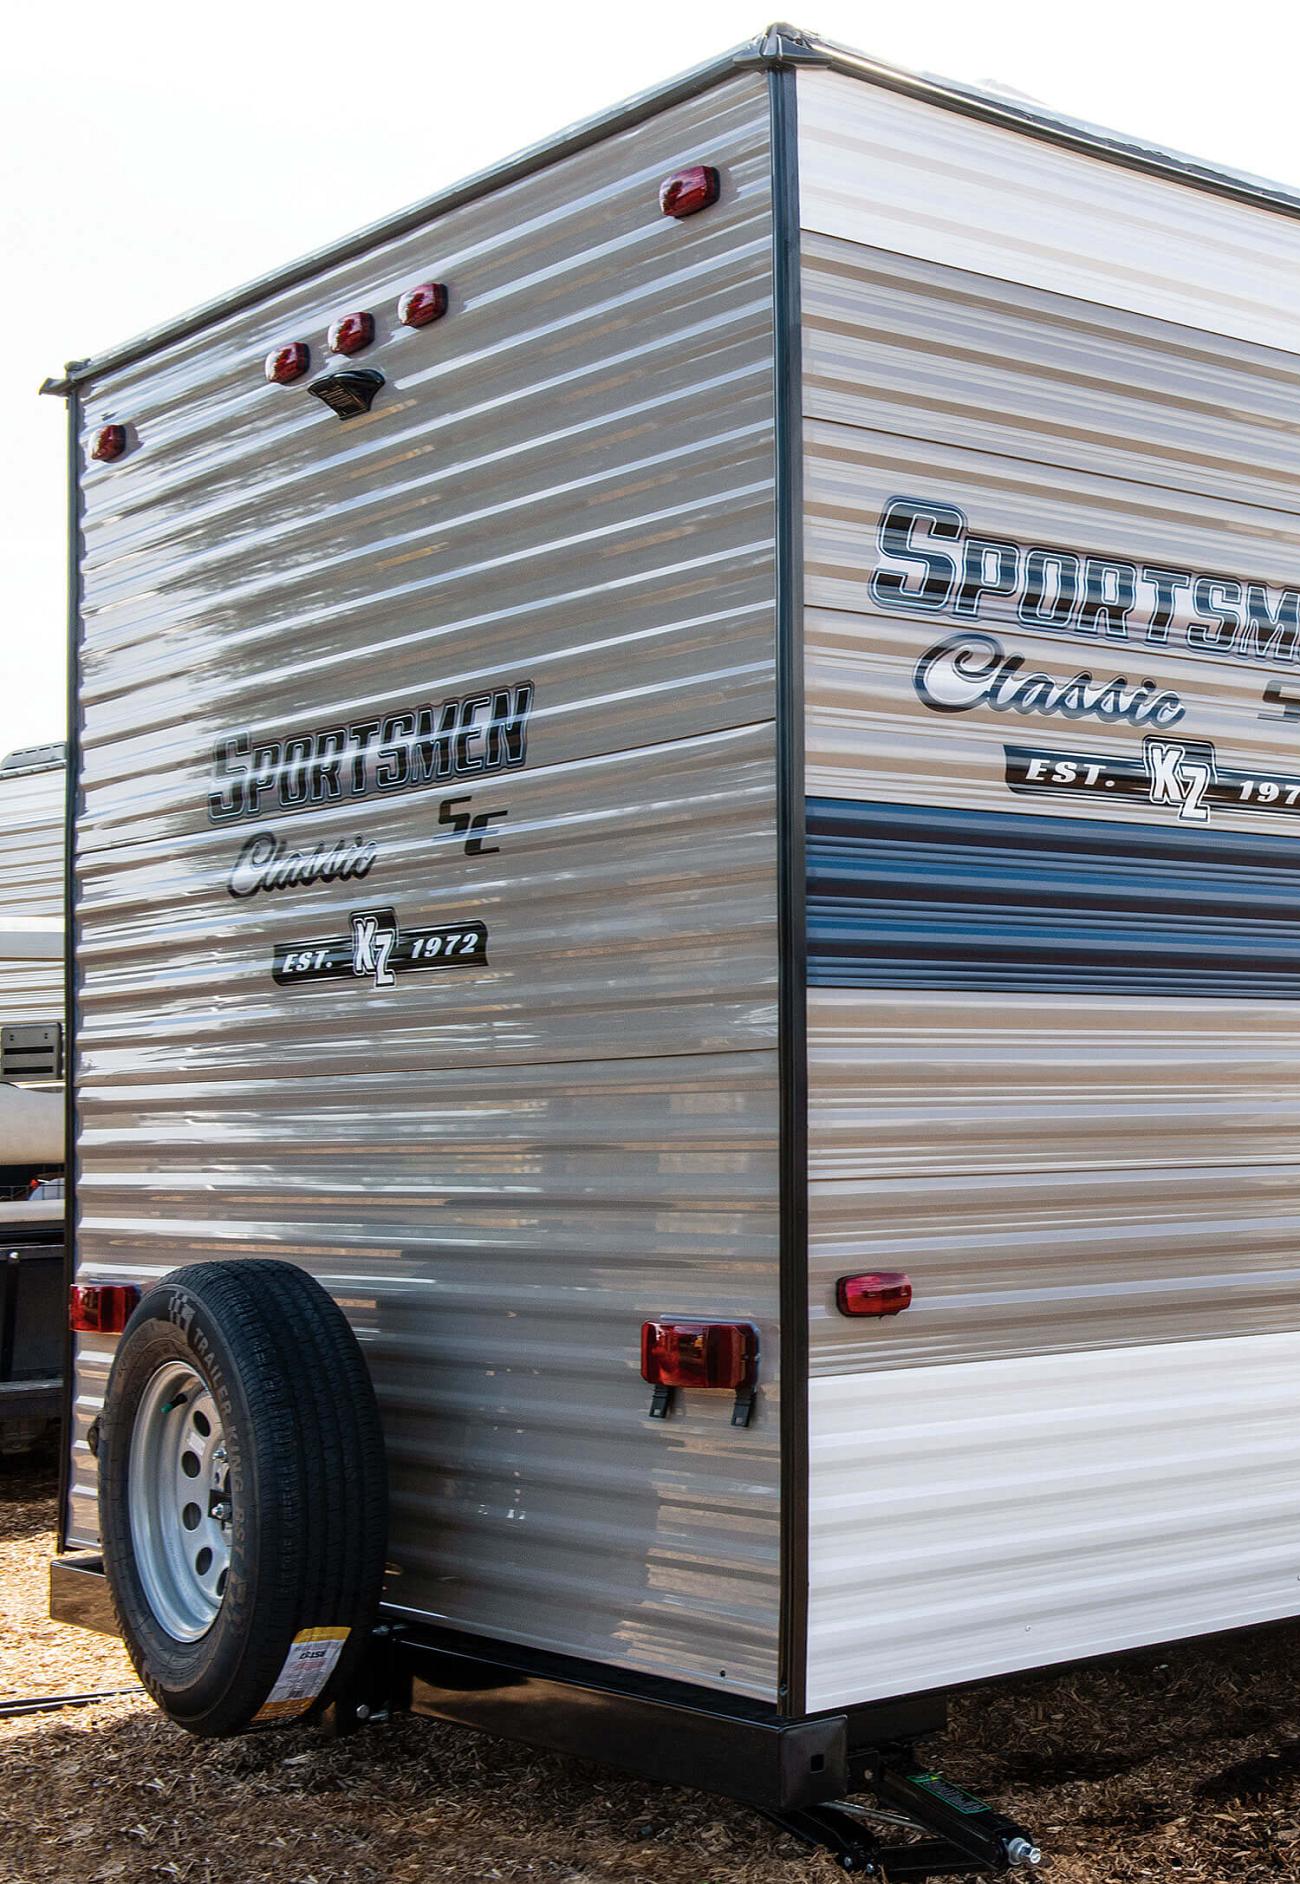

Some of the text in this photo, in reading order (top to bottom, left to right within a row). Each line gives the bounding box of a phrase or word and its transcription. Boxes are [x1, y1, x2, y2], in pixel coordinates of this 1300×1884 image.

[913, 632, 1186, 728] Classic
[207, 681, 534, 824] SPORTSMEN
[1025, 758, 1115, 788] EST.
[1147, 742, 1212, 823] KZ
[228, 832, 377, 898] Classic
[432, 796, 508, 857] SE
[281, 916, 479, 988] EST. KZ 1972
[193, 1326, 231, 1417] TRAILER
[227, 1424, 244, 1493] KING
